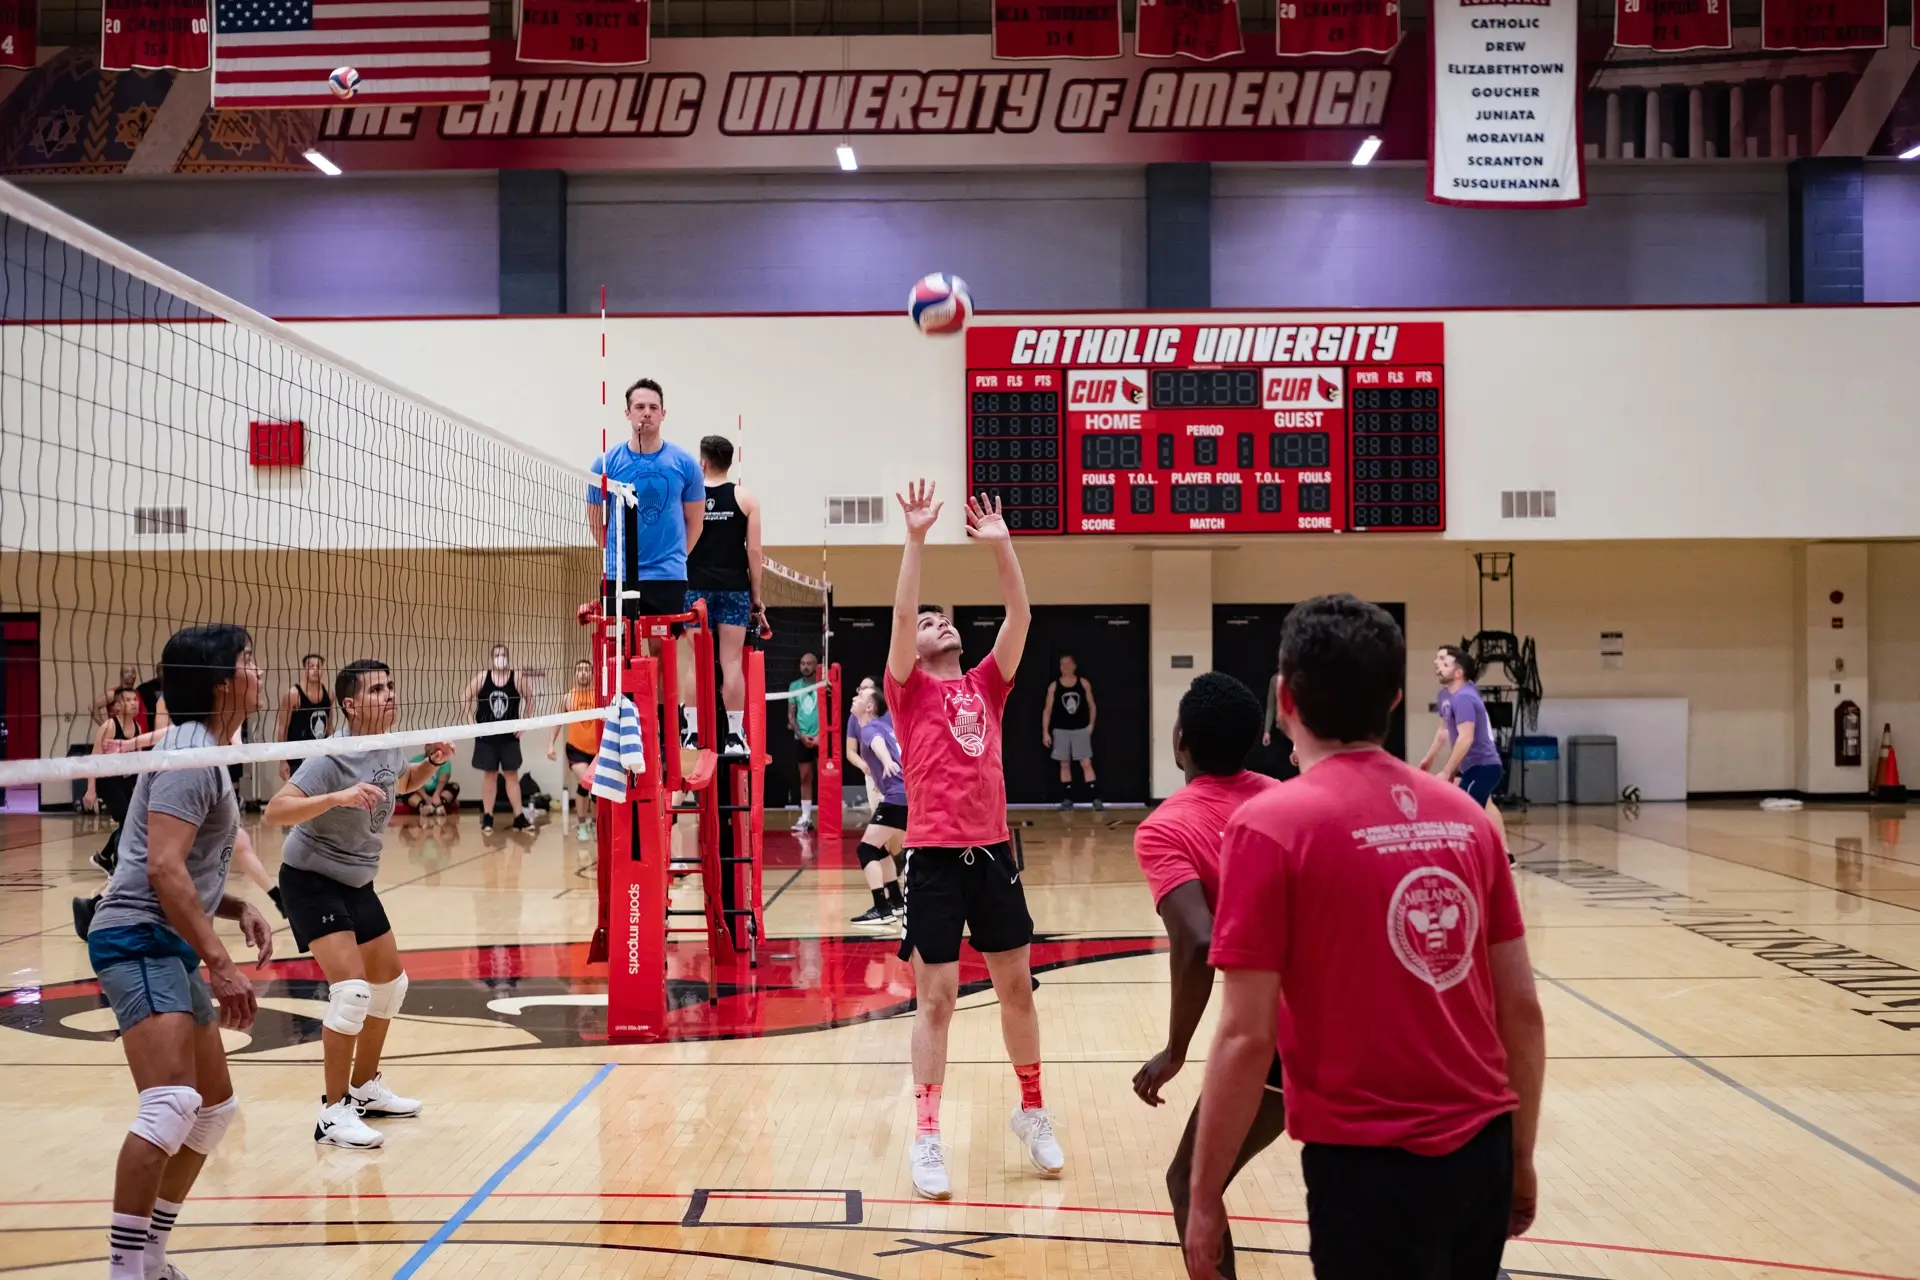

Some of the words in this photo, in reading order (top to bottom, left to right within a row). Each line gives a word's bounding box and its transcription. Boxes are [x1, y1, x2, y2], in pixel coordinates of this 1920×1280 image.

[105, 18, 121, 34] 20
[191, 17, 208, 34] 00
[575, 12, 622, 28] SWEET
[1471, 18, 1541, 29] CATHOLIC
[1, 35, 14, 54] 4
[1485, 41, 1527, 52] DREW
[1448, 63, 1565, 75] ELIZABETHTOWN
[1471, 87, 1541, 98] GOUCHER
[438, 72, 706, 138] CATHOLIC
[719, 70, 1051, 135] UNIVERSITY
[1055, 78, 1128, 133] OF
[1129, 66, 1394, 133] AMERICA
[1475, 110, 1536, 121] JUNIATA
[1466, 133, 1545, 144] MORAVIAN
[1468, 156, 1544, 167] SCRANTON
[1452, 177, 1560, 190] SUSQUEHANNA
[1010, 328, 1183, 365] CATHOLIC
[1192, 325, 1400, 364] UNIVERSITY
[975, 376, 998, 388] PLYR
[1006, 376, 1023, 388] FLS
[1034, 375, 1052, 387] PTS
[1356, 371, 1380, 384] PLYR
[1387, 371, 1405, 384] FLS
[1415, 371, 1433, 383] PTS
[1070, 379, 1118, 404] CUA
[1265, 377, 1313, 402] CUA
[1085, 414, 1142, 430] HOME
[1274, 412, 1324, 428] GUEST
[1186, 425, 1224, 436] PERIOD
[1082, 473, 1116, 485] FOULS
[1128, 473, 1159, 485] T.O.L.
[1171, 472, 1212, 485] PLAYER
[1216, 472, 1243, 484] FOUL
[1255, 472, 1285, 484] T.O.L.
[1298, 471, 1332, 483] FOULS
[1081, 519, 1115, 531] SCORE
[1190, 518, 1225, 530] MATCH
[1298, 517, 1332, 529] SCORE
[628, 883, 640, 924] sports
[627, 925, 640, 975] imports
[1662, 918, 1920, 1031] IVERSITY
